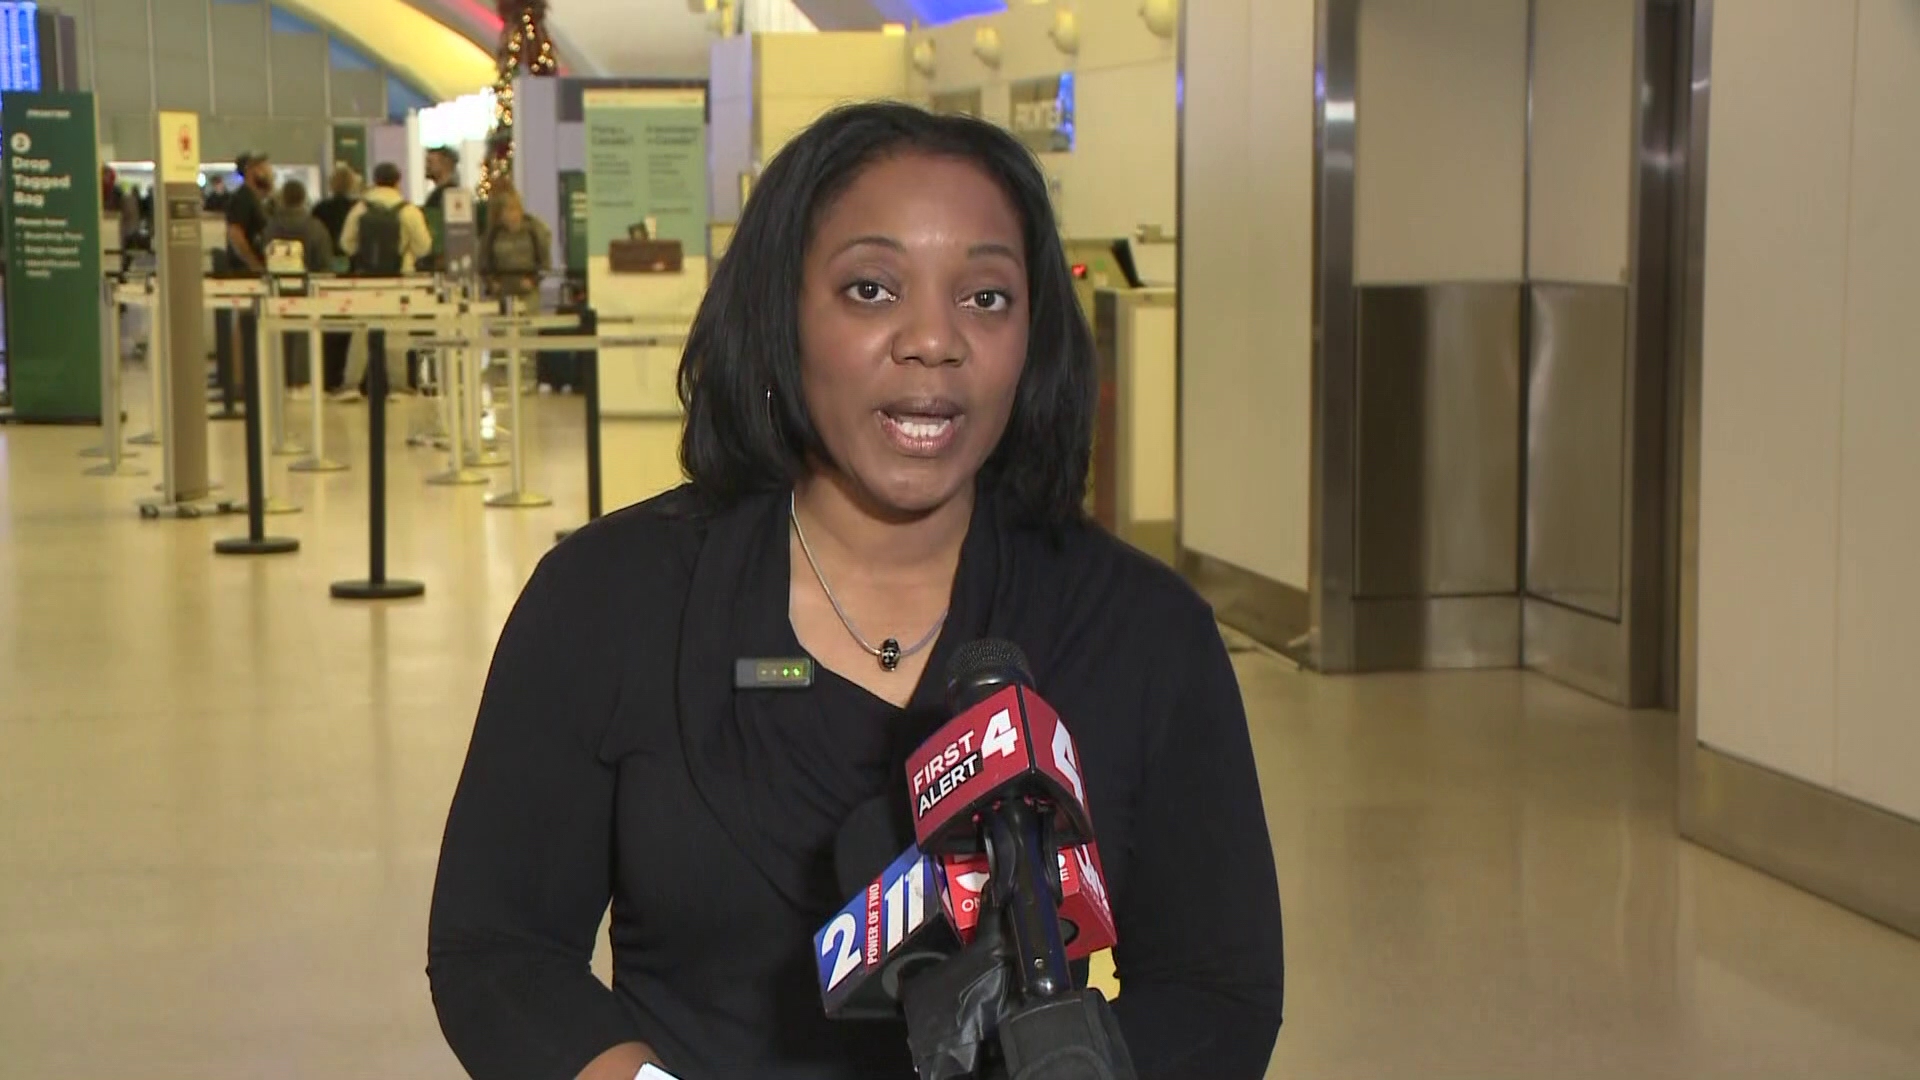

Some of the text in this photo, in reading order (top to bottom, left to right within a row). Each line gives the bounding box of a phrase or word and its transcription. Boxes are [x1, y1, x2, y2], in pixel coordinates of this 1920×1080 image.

[12, 156, 51, 172] Drop
[13, 173, 71, 191] Tagged
[14, 191, 45, 208] Bag
[912, 730, 974, 795] FIRST
[981, 708, 1018, 759] 4
[919, 754, 978, 818] ALERT
[867, 883, 880, 965] POWER OF TWO
[884, 855, 924, 954] 11
[822, 912, 862, 993] 2
